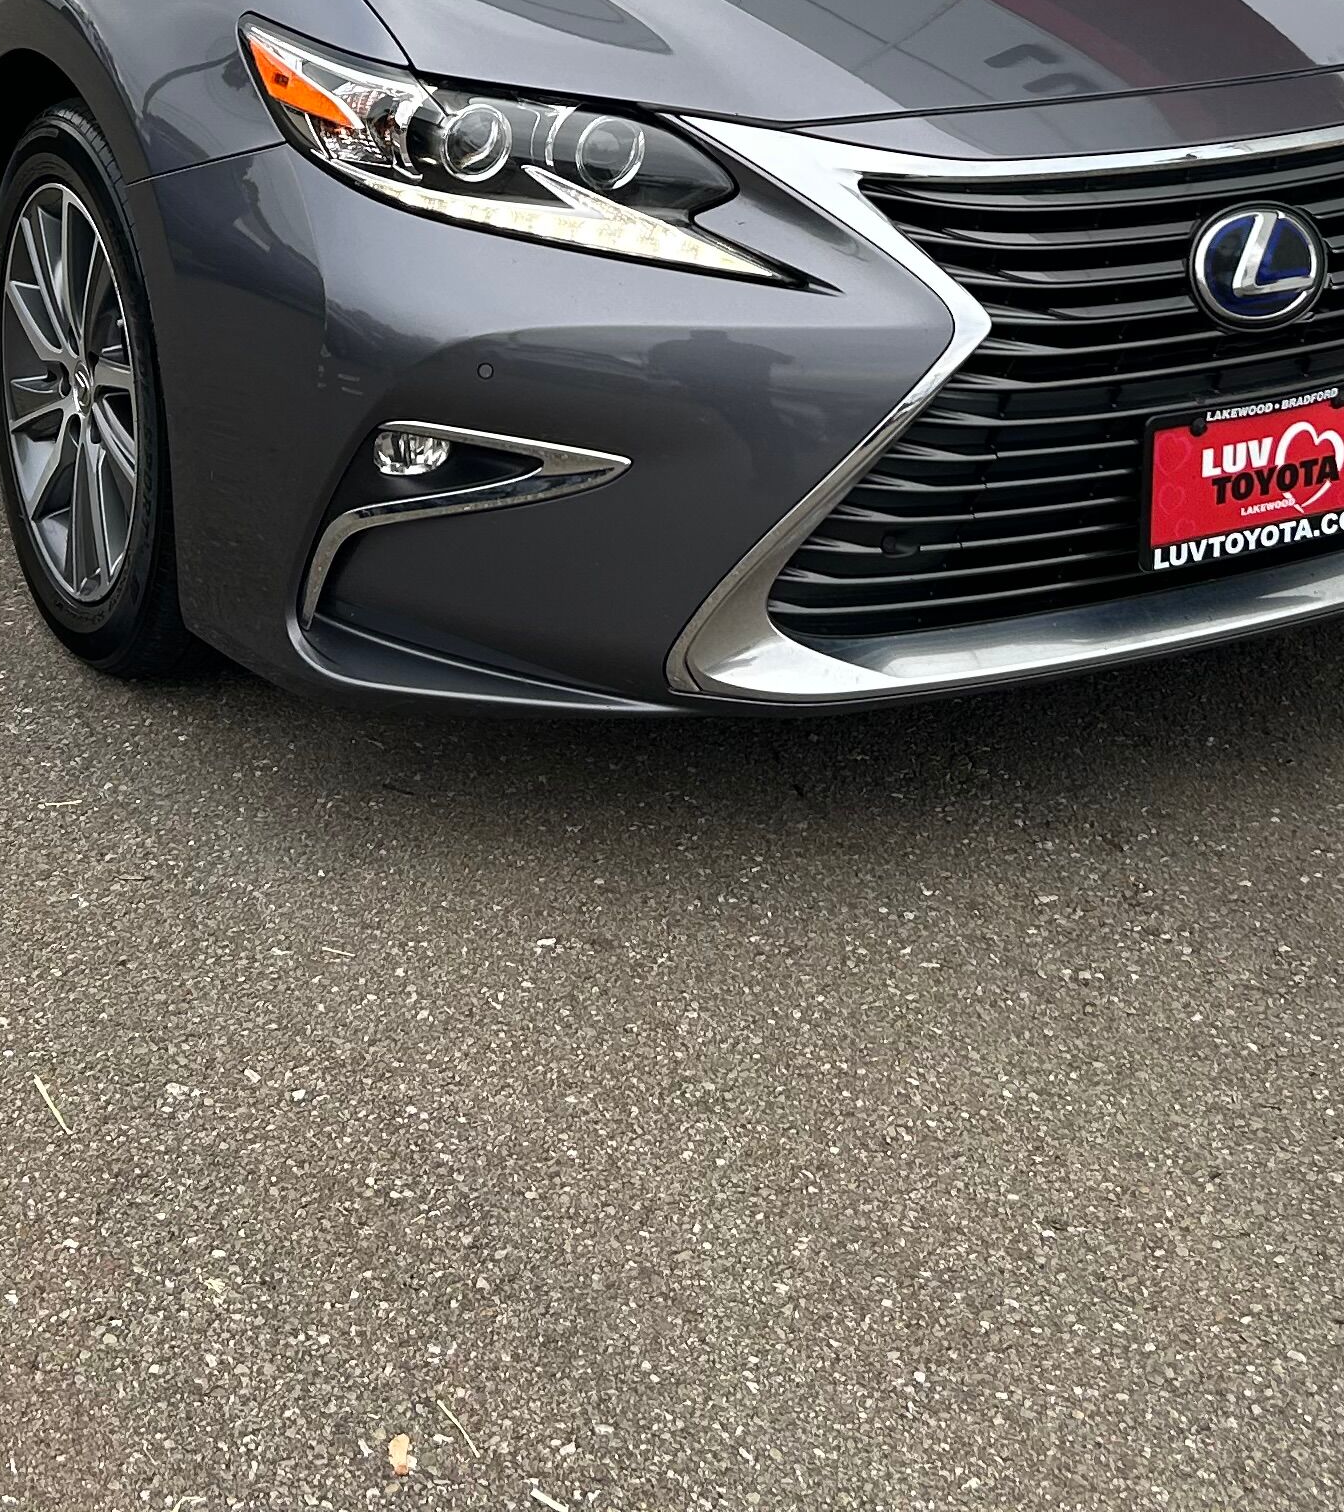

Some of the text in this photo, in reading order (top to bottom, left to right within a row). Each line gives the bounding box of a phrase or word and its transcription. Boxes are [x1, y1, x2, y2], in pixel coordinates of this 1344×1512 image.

[1206, 387, 1338, 421] LAKEWOOD BRADFORD
[1201, 436, 1273, 478] LUV
[1212, 454, 1340, 505] TOYOTA
[1240, 497, 1296, 516] LAKEWOOD
